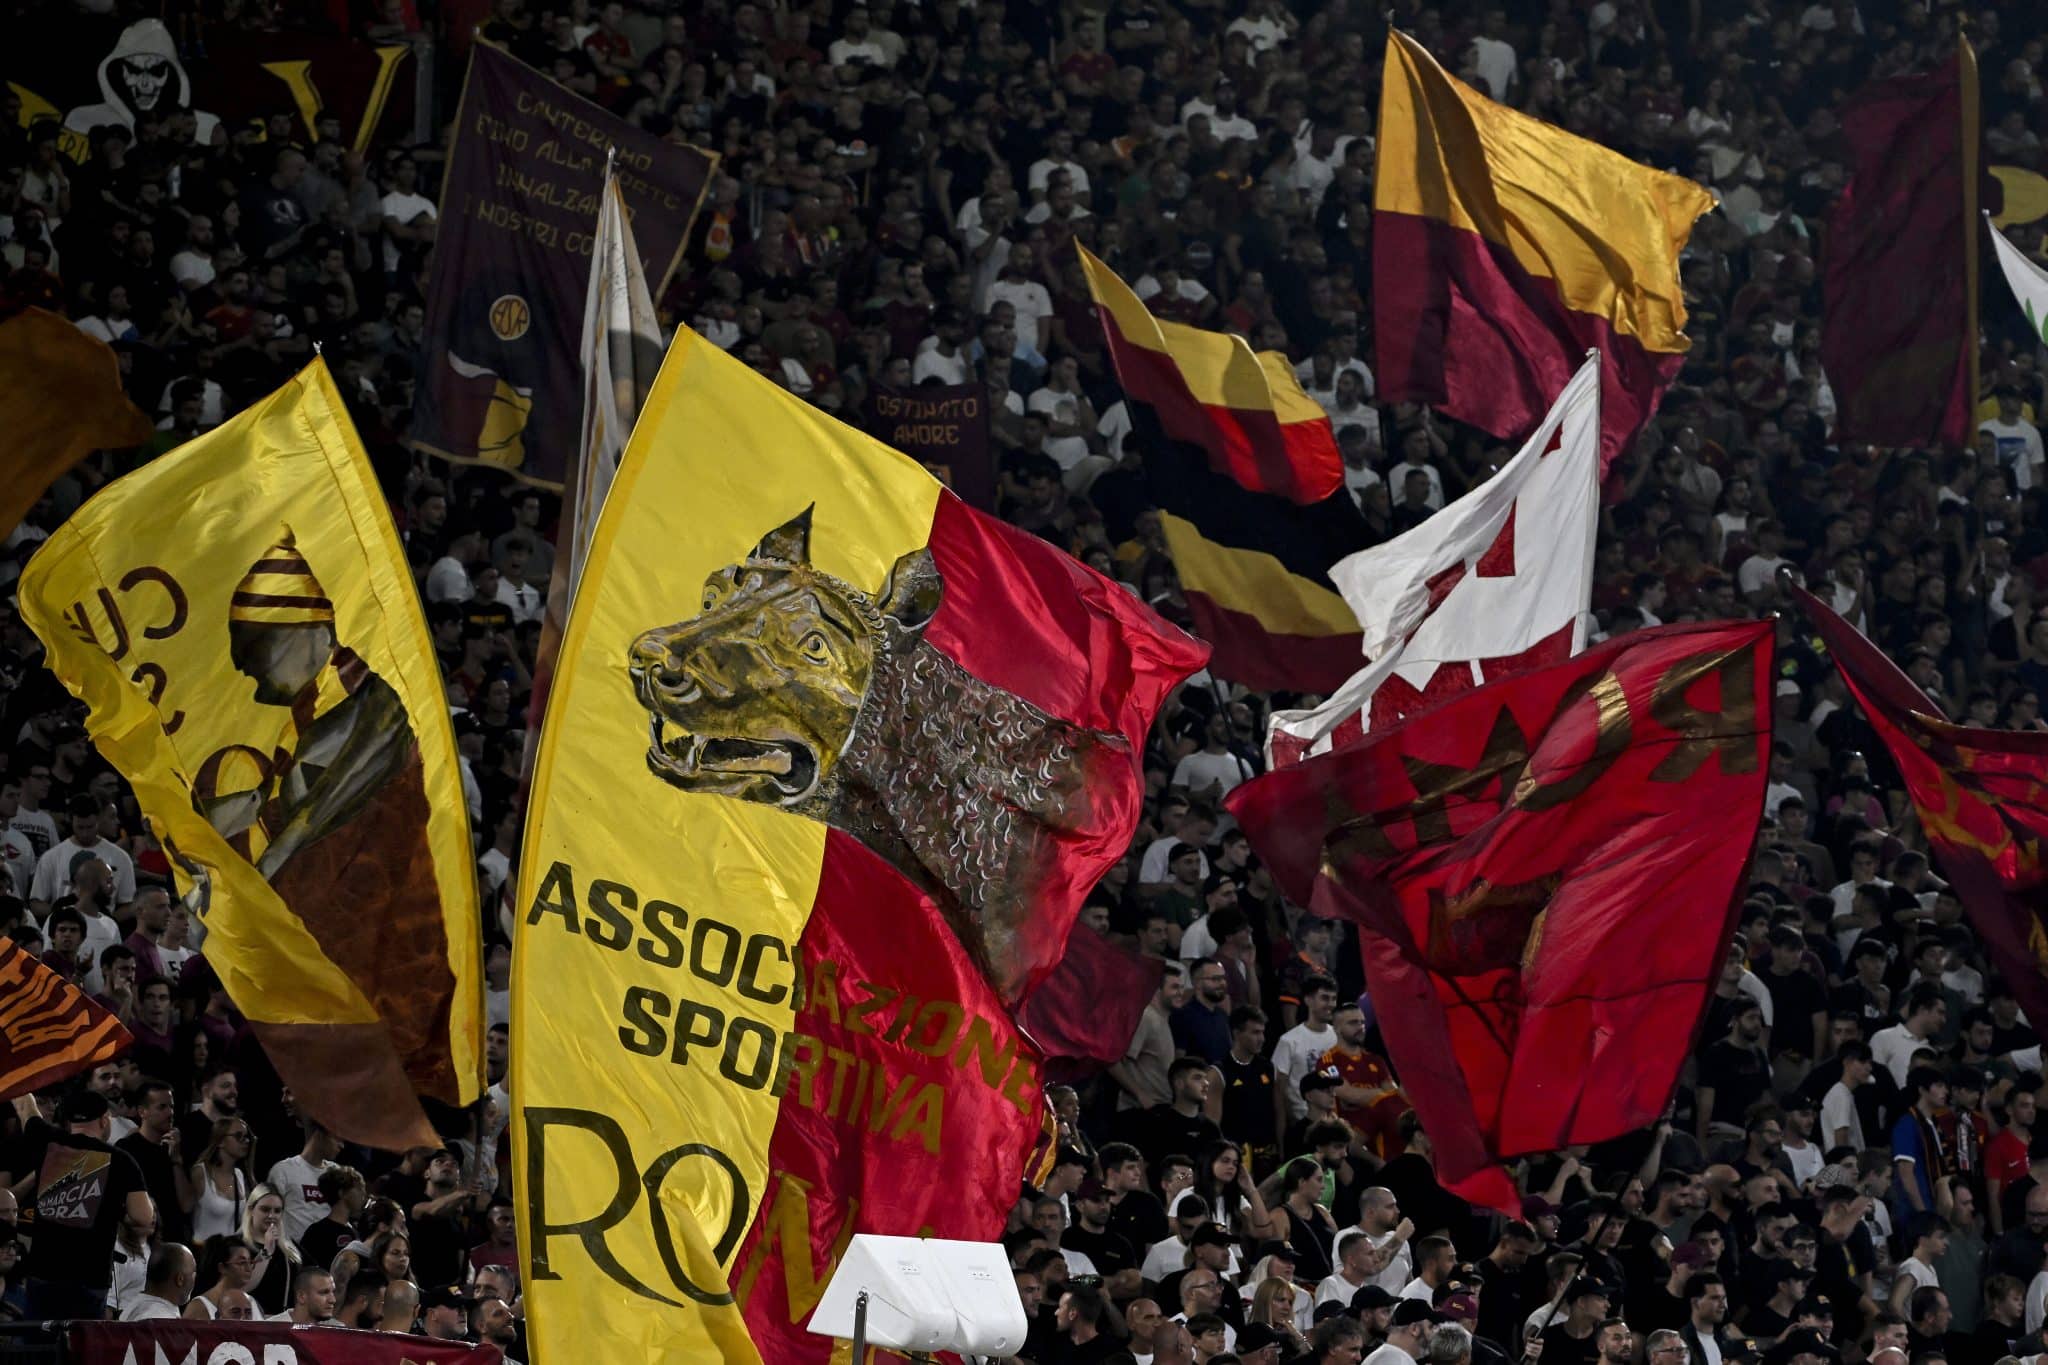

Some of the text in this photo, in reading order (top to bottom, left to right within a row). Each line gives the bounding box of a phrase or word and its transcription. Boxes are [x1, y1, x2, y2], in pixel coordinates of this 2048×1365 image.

[476, 112, 529, 152] FINO
[535, 139, 593, 172] ALLA
[496, 163, 637, 223] INNALZAN
[876, 395, 977, 419] OSTINATO
[893, 423, 961, 445] AMORE
[526, 861, 1039, 1115] ASSOCIAZIONE
[618, 985, 946, 1156] SPORTIVA
